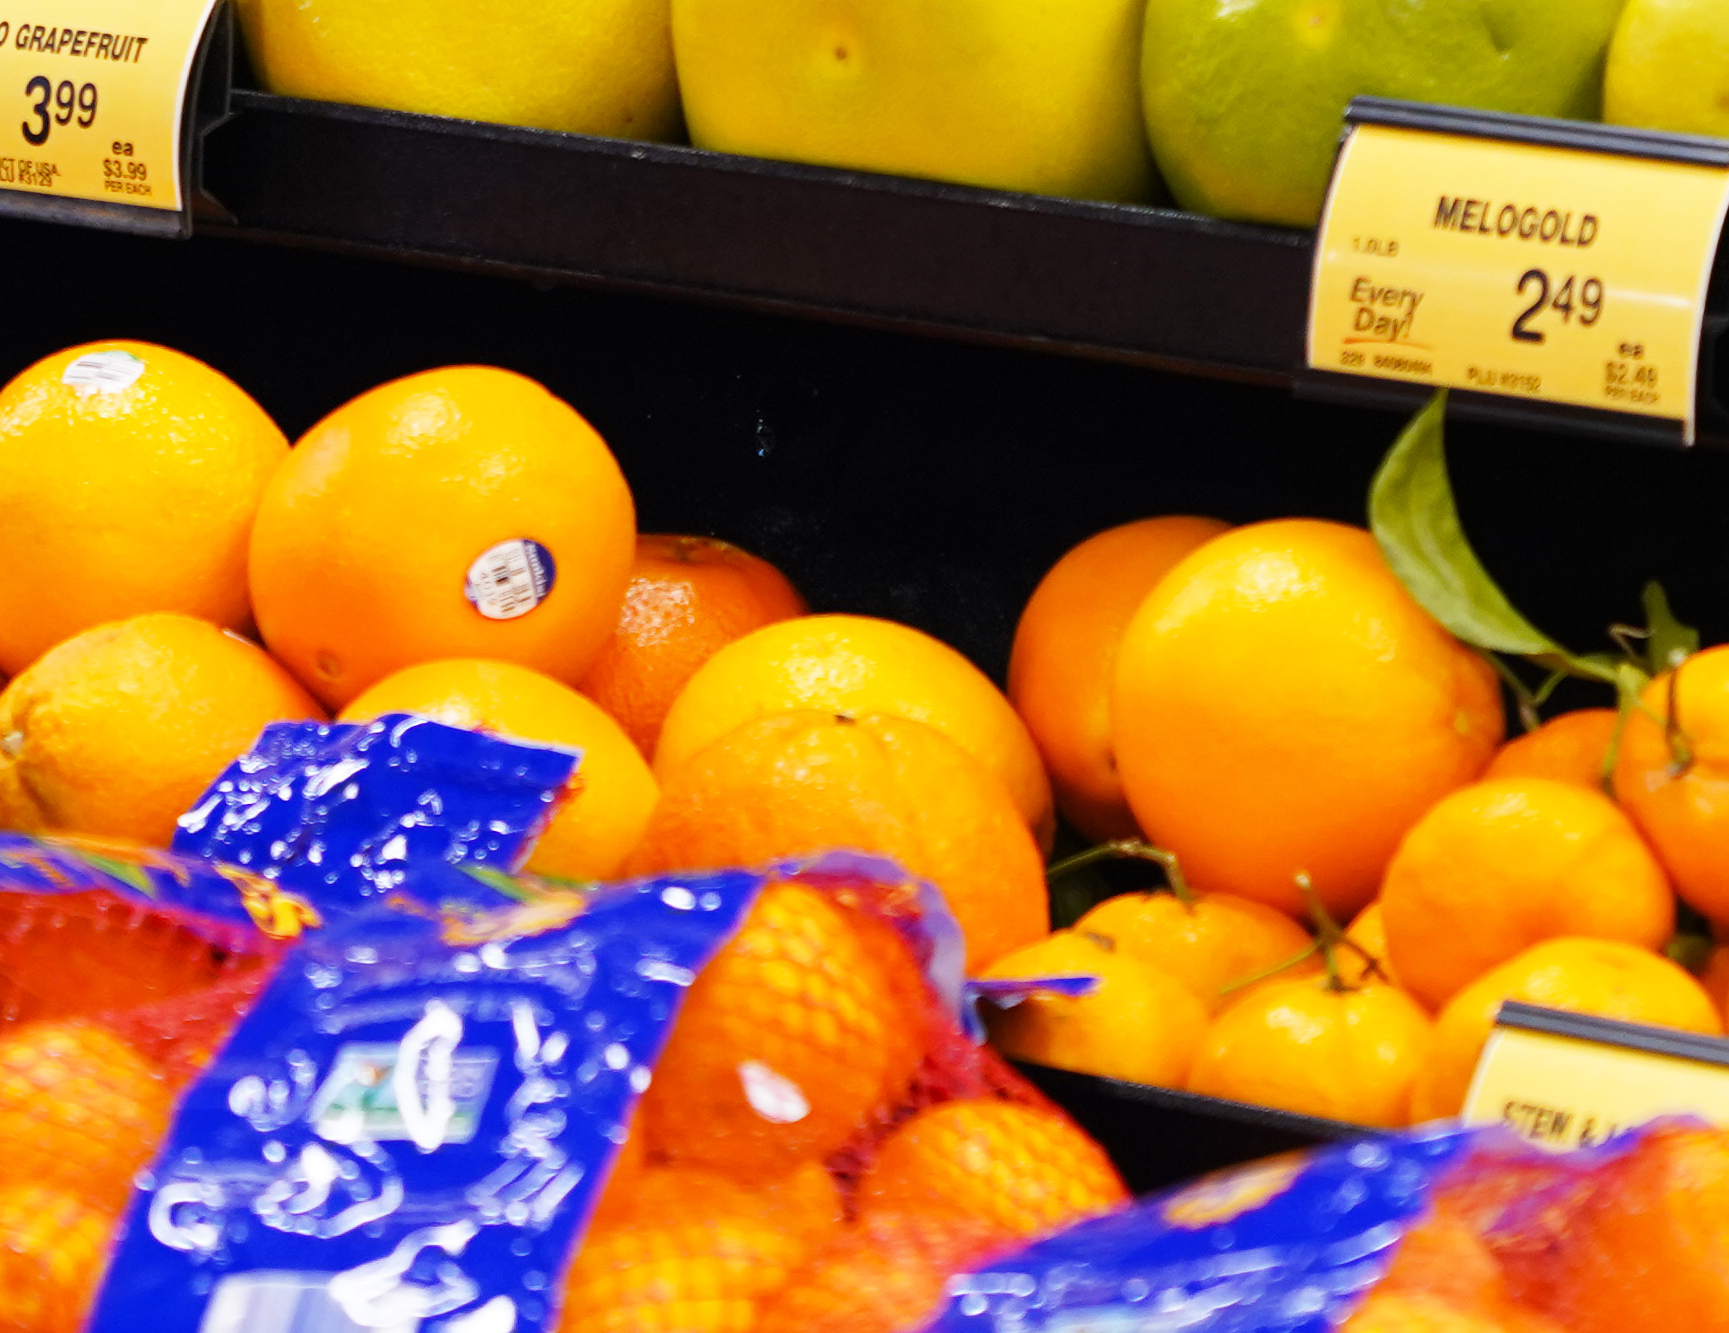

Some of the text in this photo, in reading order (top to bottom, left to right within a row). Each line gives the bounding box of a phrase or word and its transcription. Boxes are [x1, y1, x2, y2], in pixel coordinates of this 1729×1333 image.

[15, 23, 148, 64] GRAPEFRUIT
[112, 141, 133, 156] ea
[103, 159, 147, 181] $3.99
[1434, 195, 1600, 247] MELOGOLD
[1350, 277, 1424, 317] Every
[1354, 307, 1414, 342] Day!
